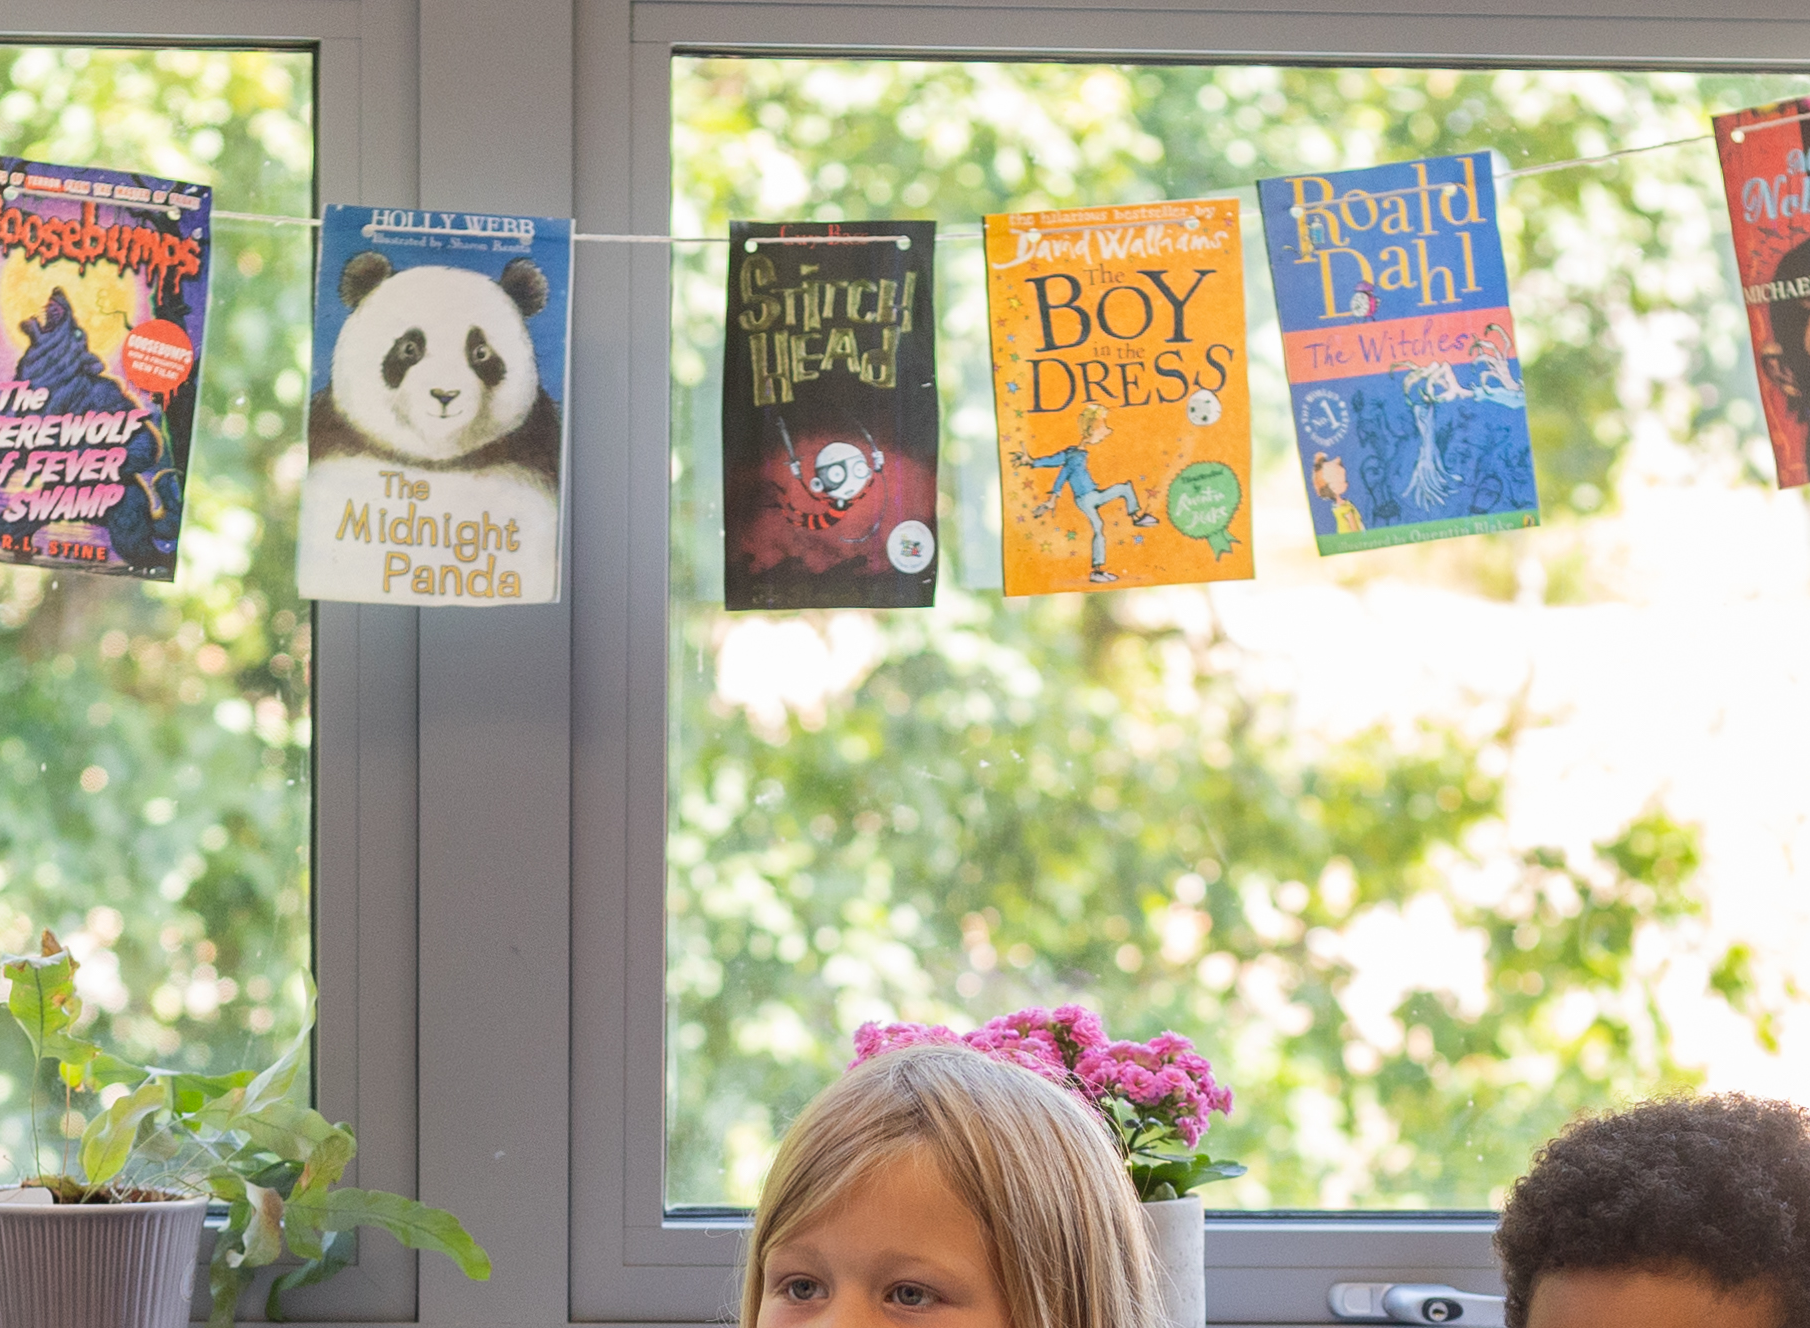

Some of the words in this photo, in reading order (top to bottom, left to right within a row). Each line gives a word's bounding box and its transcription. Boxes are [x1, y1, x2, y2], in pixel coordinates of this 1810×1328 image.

[372, 209, 456, 230] HOLLY
[464, 215, 535, 236] WEBB
[1041, 208, 1108, 224] hilarious
[1113, 205, 1189, 220] bestseller
[1194, 205, 1216, 219] by
[1284, 157, 1487, 264] Roald
[992, 227, 1093, 270] David
[1095, 224, 1230, 260] Walliams
[1083, 264, 1125, 286] The
[1313, 232, 1482, 320] Dahl
[1024, 269, 1217, 352] BOY
[1093, 341, 1111, 357] in
[1116, 342, 1145, 359] the
[1303, 336, 1350, 368] The
[1357, 319, 1470, 363] Witches
[1026, 344, 1234, 413] DRESS
[22, 447, 127, 486] FEVER
[379, 470, 430, 501] The
[3, 483, 126, 523] SWAMP
[48, 540, 107, 561] STINE
[335, 499, 521, 562] Midnight
[1409, 525, 1470, 543] Quentin
[1473, 518, 1515, 534] Blake
[383, 551, 522, 598] Panda
